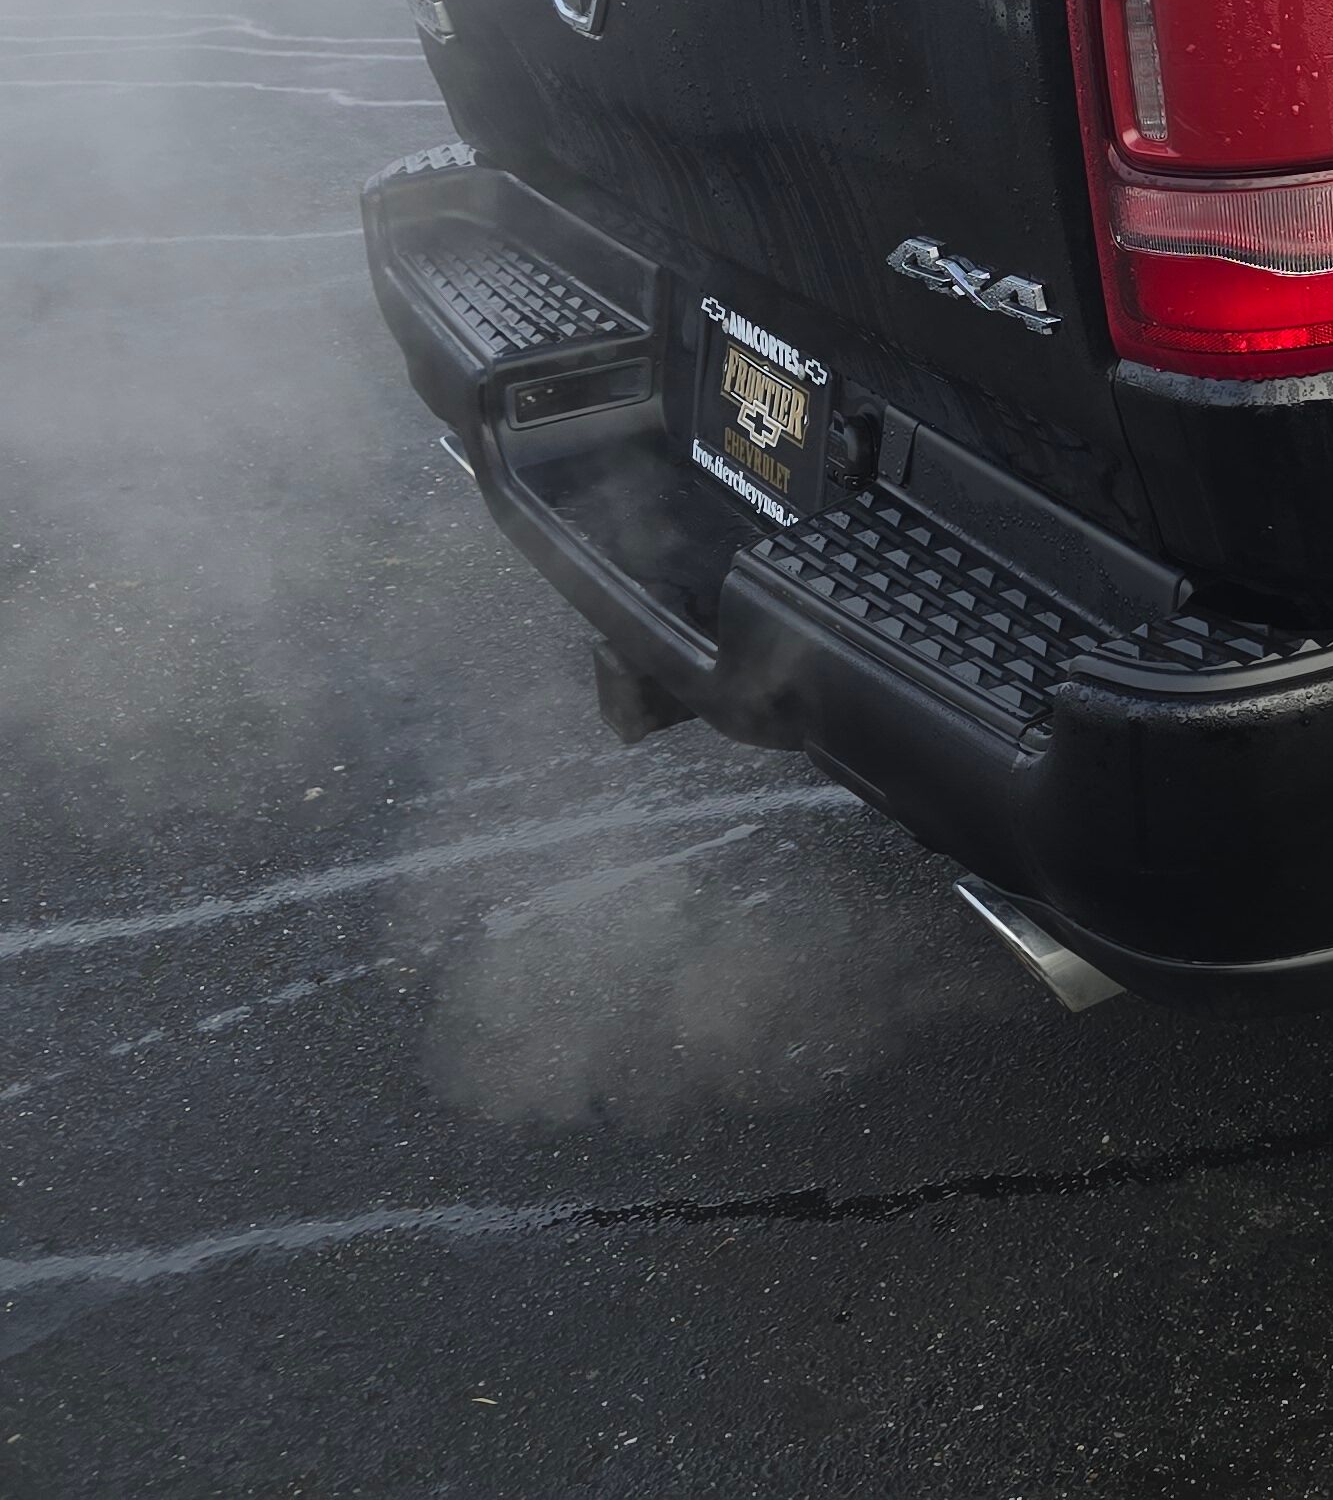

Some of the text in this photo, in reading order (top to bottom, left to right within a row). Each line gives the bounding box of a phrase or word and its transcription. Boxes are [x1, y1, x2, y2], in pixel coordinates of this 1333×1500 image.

[729, 311, 800, 376] ANACORTES
[723, 347, 806, 440] FRONTIER
[724, 426, 791, 494] CHEVROLET
